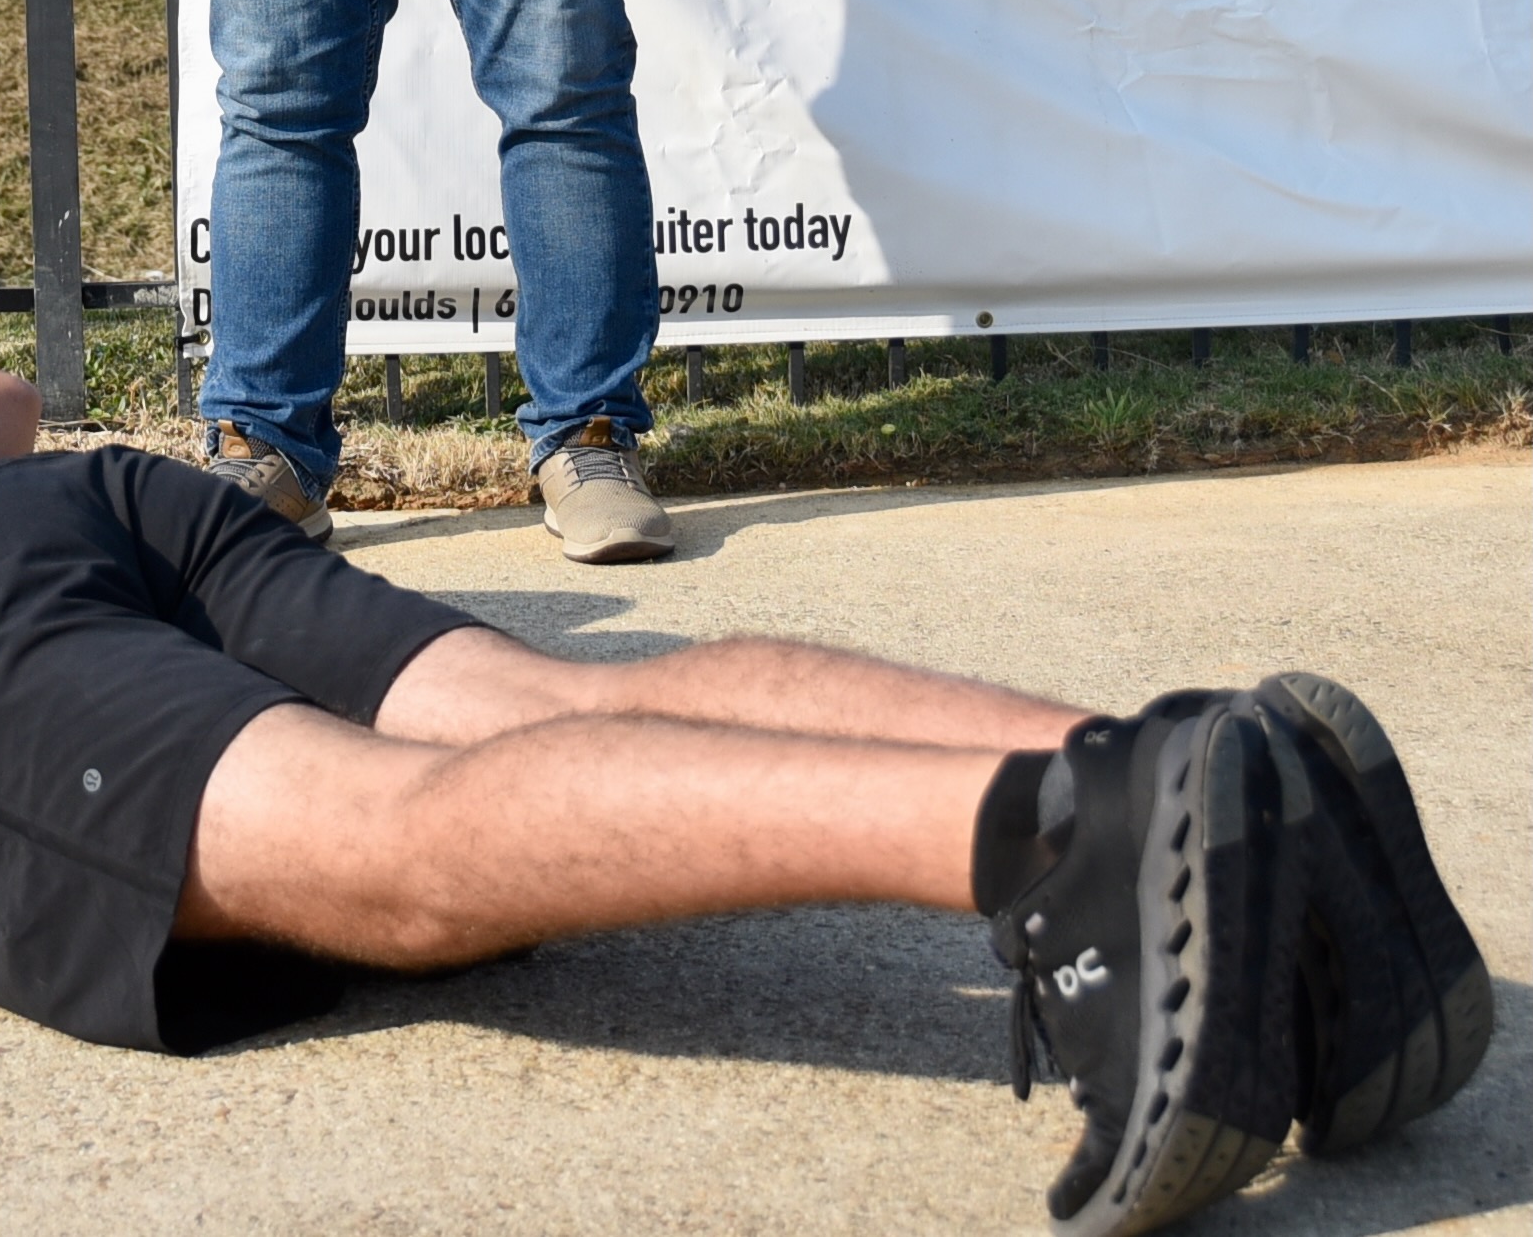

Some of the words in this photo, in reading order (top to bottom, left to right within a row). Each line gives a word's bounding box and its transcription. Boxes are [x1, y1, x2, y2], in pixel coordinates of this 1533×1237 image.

[351, 227, 441, 275] your
[743, 202, 852, 262] today
[347, 289, 458, 322] oulds
